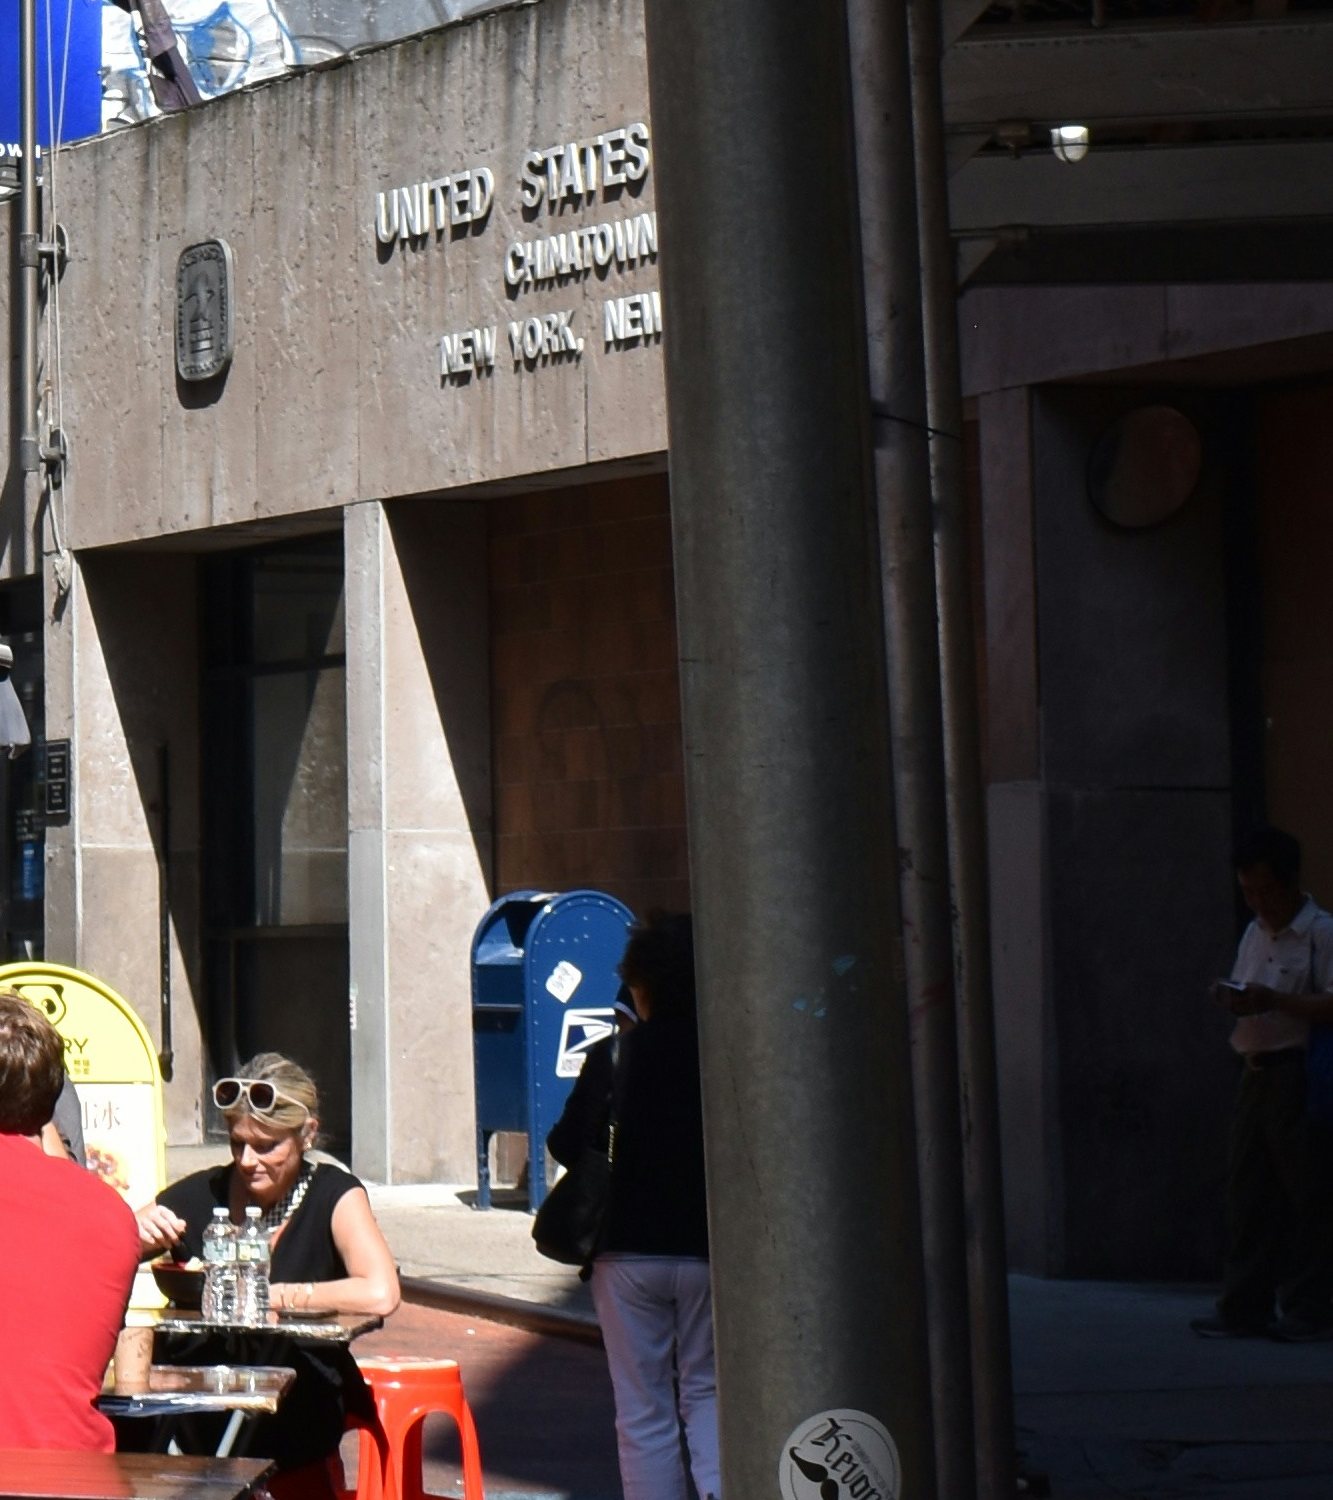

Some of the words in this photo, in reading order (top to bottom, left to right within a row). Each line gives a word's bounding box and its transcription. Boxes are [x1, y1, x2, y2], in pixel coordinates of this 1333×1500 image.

[376, 166, 495, 244] UNITED
[521, 122, 650, 208] STATES
[504, 211, 658, 286] CHINATOWN
[440, 325, 498, 376] NEW
[508, 310, 585, 361] YORK,
